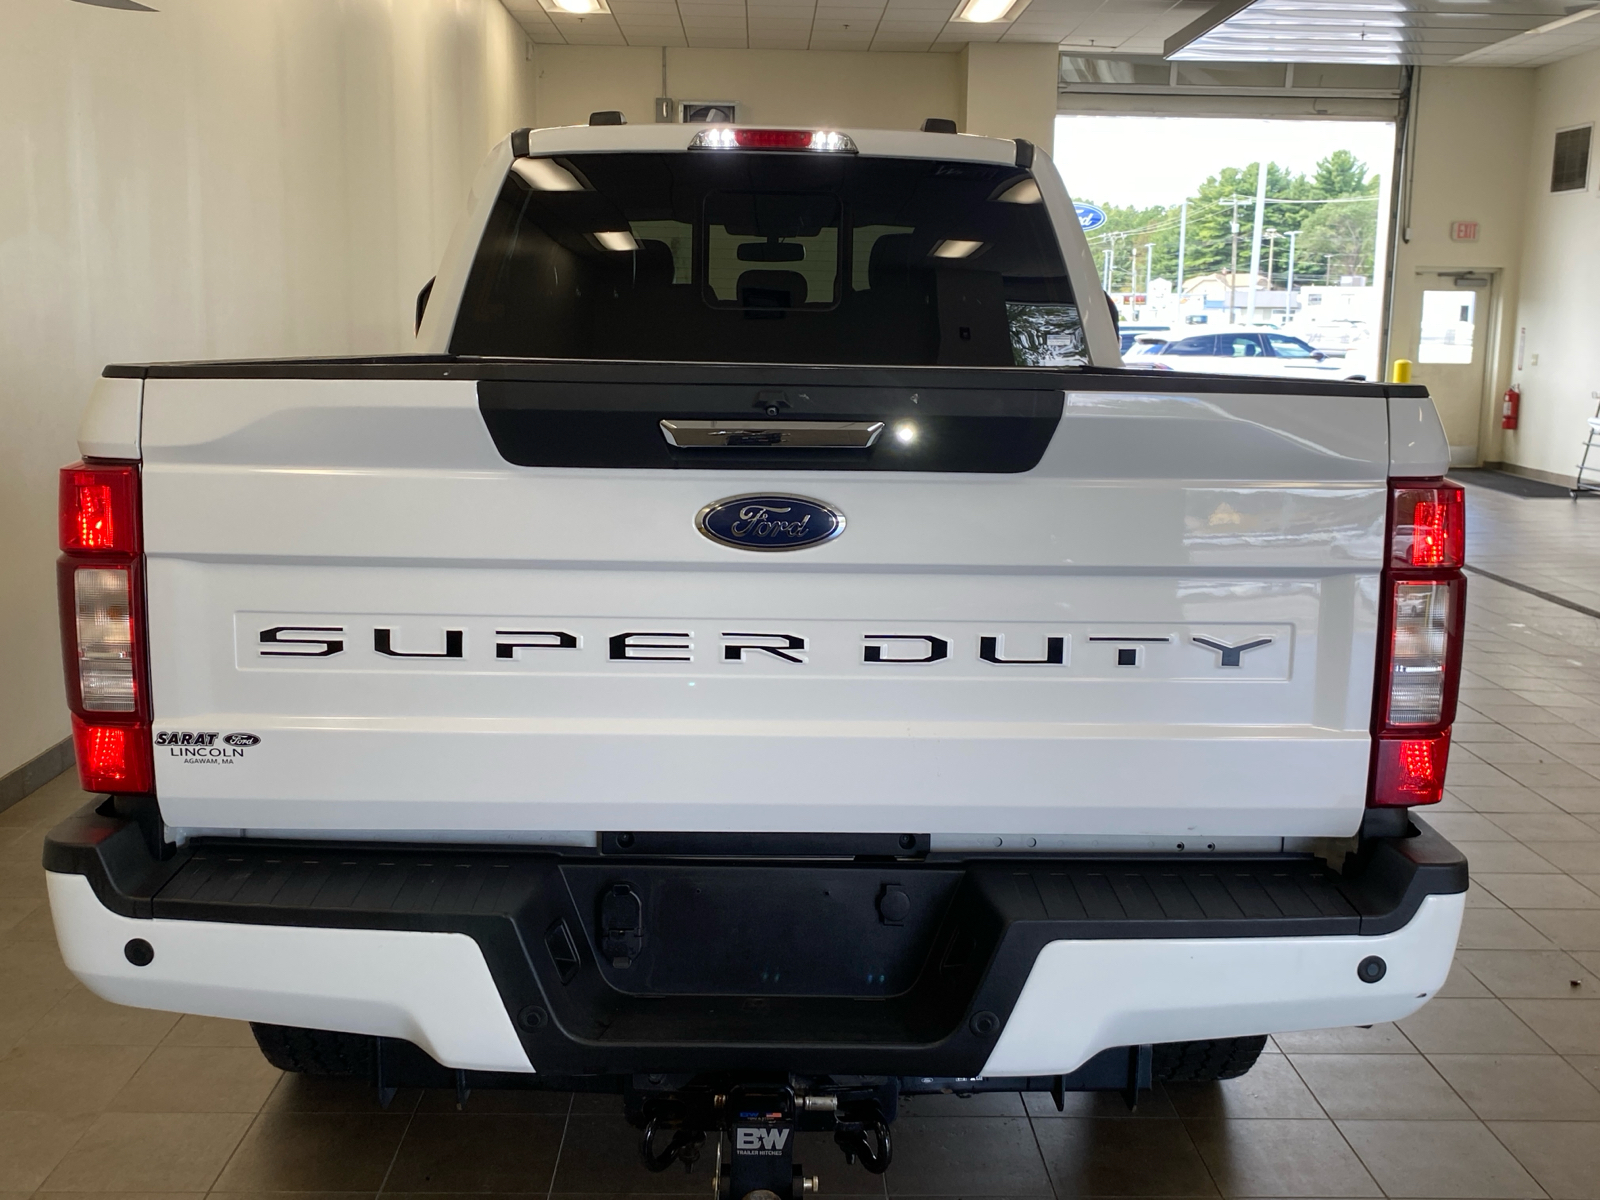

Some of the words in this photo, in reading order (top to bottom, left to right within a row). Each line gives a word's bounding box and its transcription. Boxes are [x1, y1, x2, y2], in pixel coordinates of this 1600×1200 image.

[1457, 222, 1478, 239] EXIT
[731, 505, 811, 537] Ford
[259, 626, 806, 664] SUPER
[863, 634, 1273, 667] DUTY
[155, 731, 219, 746] SARAT
[170, 748, 244, 757] LINCOLN
